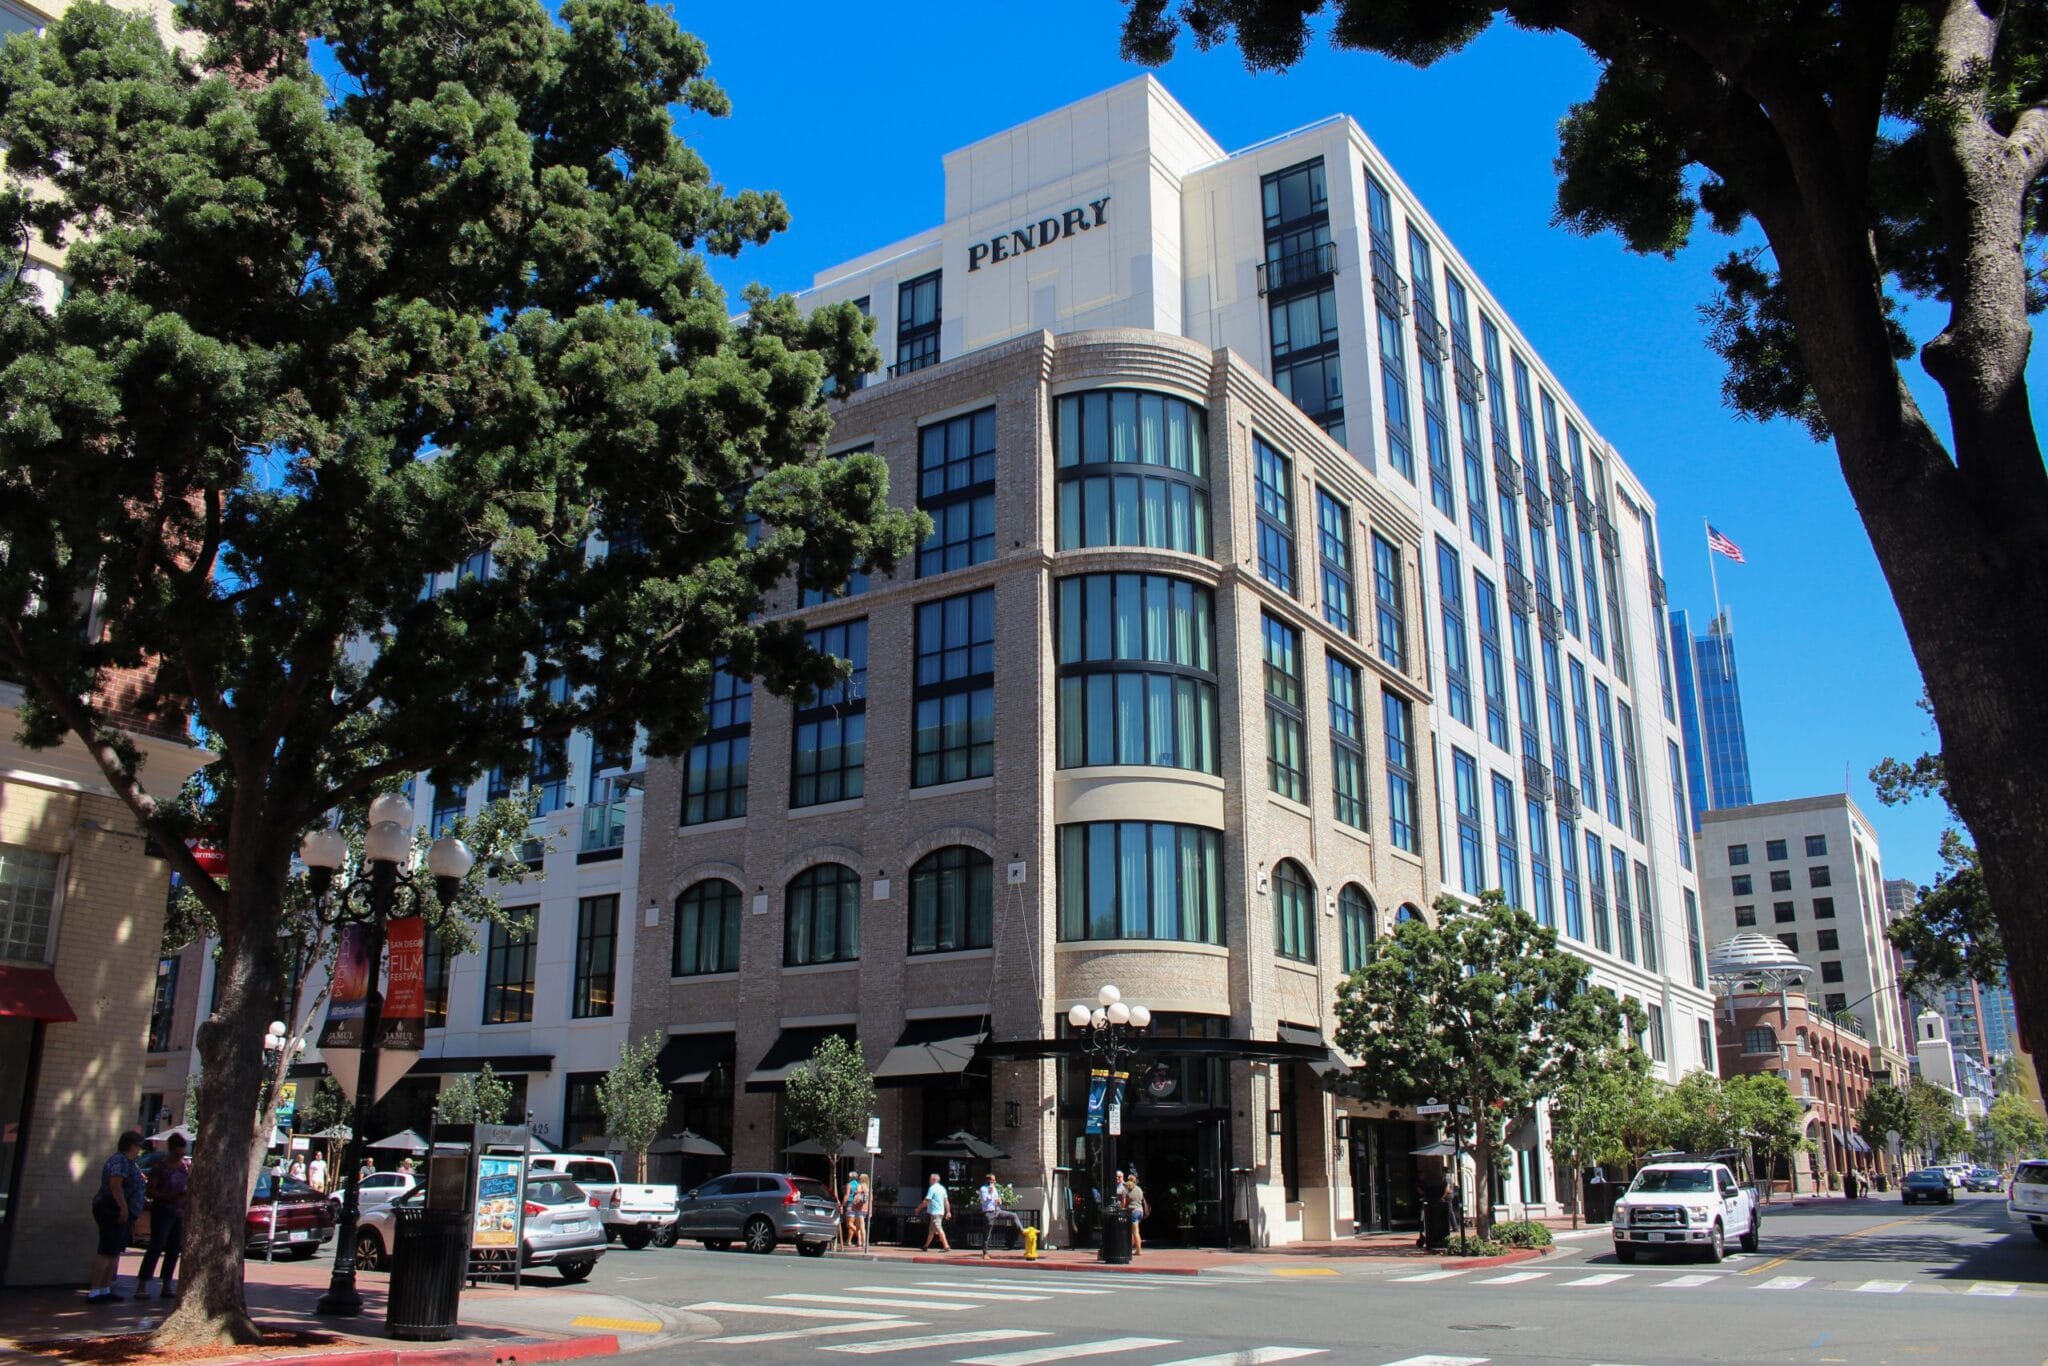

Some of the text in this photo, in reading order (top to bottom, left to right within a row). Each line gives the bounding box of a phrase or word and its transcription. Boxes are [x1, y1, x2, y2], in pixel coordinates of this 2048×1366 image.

[968, 197, 1111, 272] PENDRY
[390, 940, 403, 948] SAN
[390, 954, 424, 971] FILM
[390, 972, 424, 981] FESTIVAL
